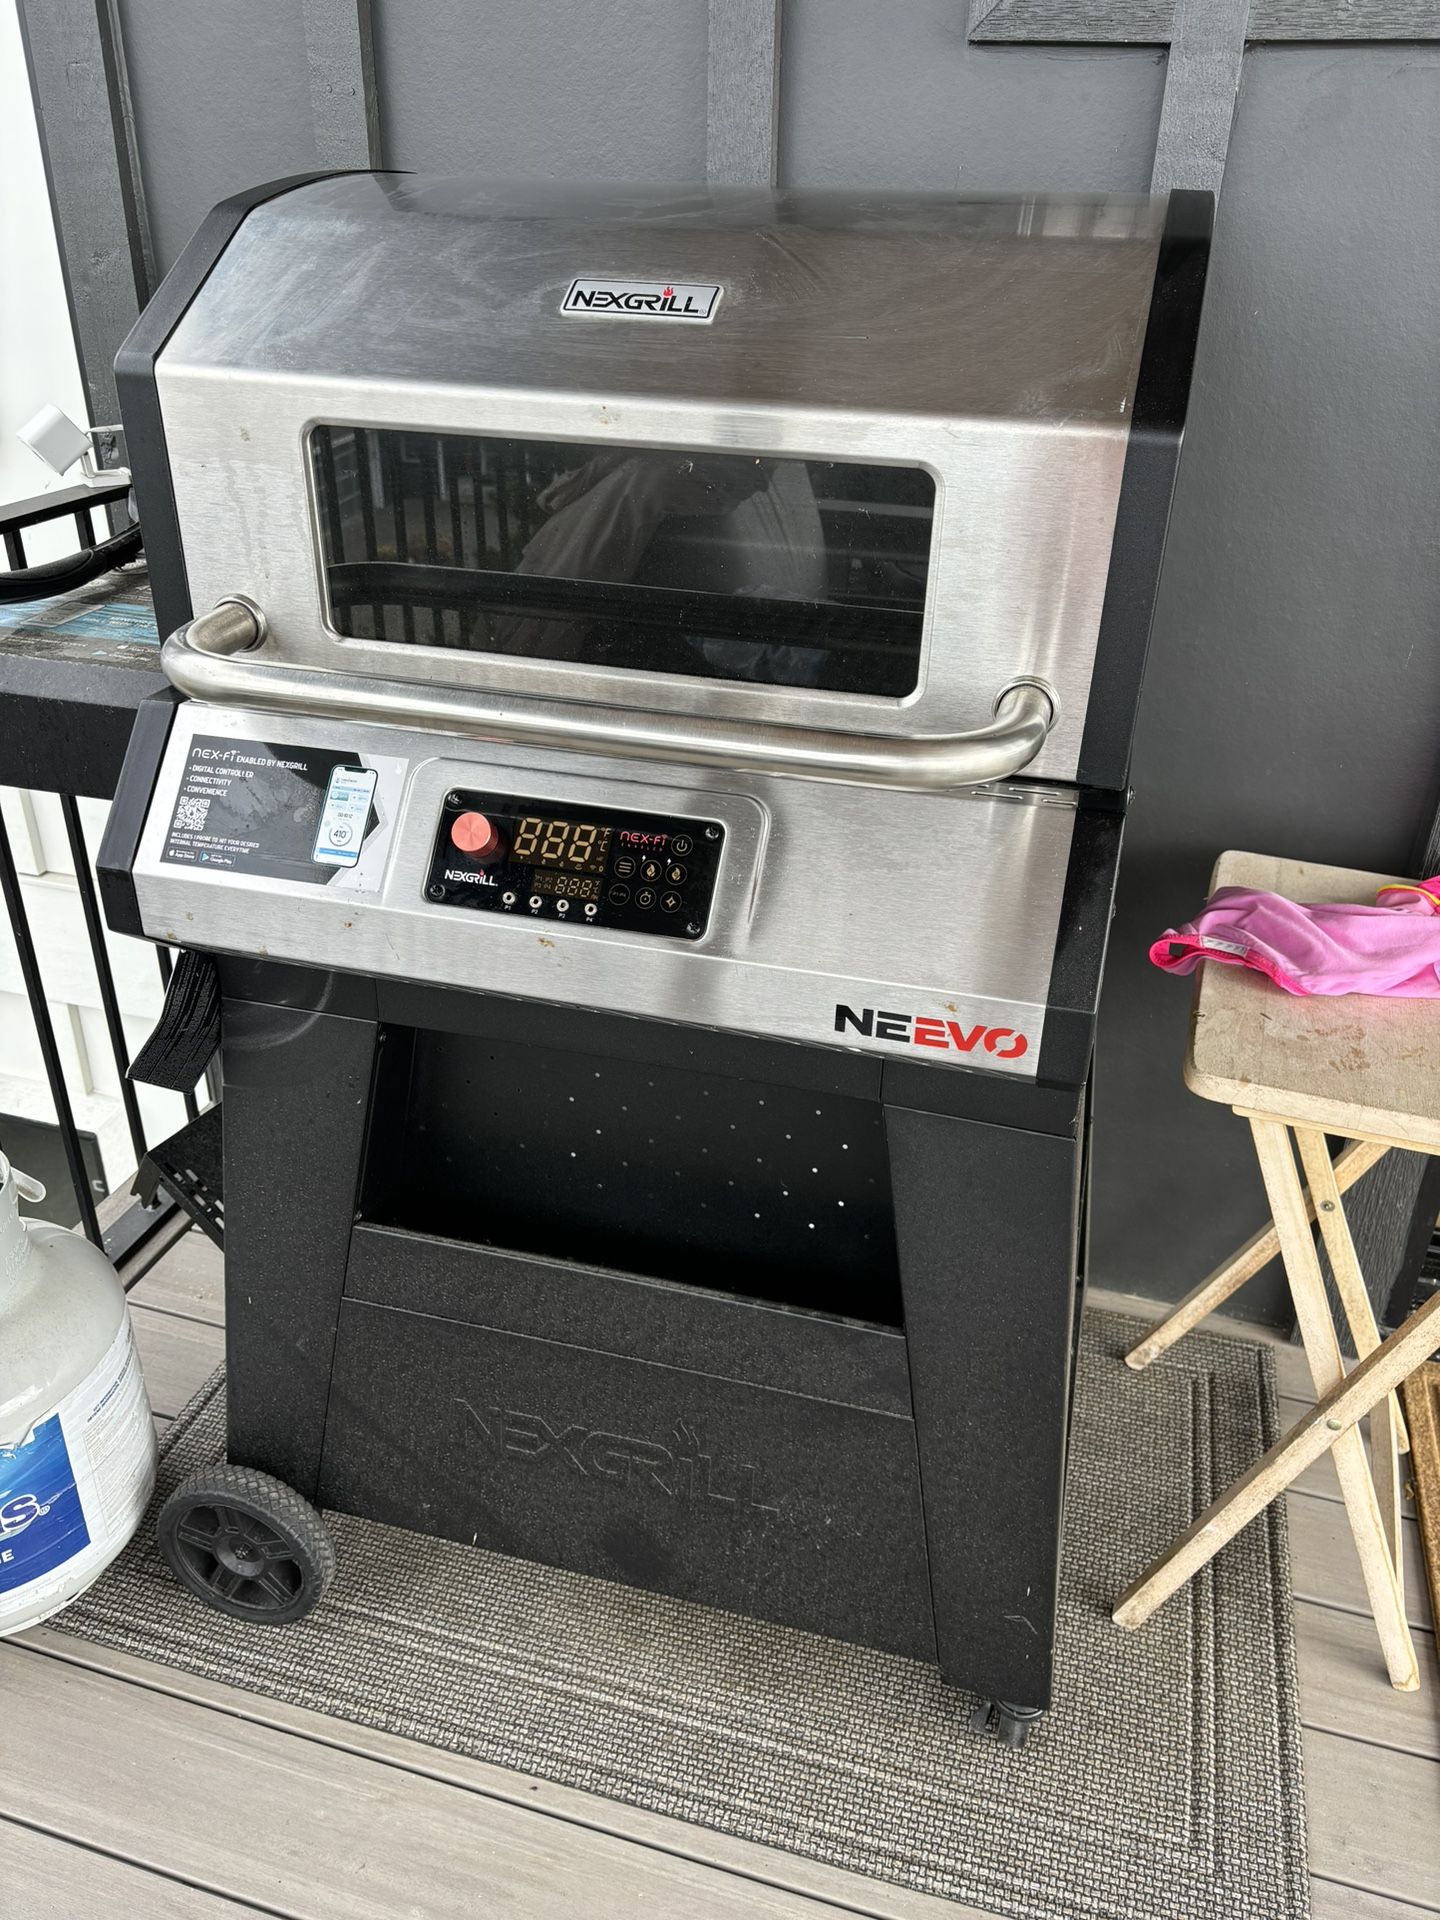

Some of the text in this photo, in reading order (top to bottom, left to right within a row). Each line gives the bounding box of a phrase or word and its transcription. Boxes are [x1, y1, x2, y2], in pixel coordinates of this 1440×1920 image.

[572, 288, 699, 313] NEXGRILL
[192, 764, 254, 778] DIGITAL CONTROLLER
[236, 755, 267, 766] ENABLED
[267, 758, 277, 767] BY
[276, 760, 308, 771] NEXGRILL
[189, 775, 232, 786] CONNECTIVITY
[187, 785, 228, 797] CONVENIENCE
[444, 869, 498, 887] NEXGRILL
[834, 1004, 1028, 1059] NEEVO
